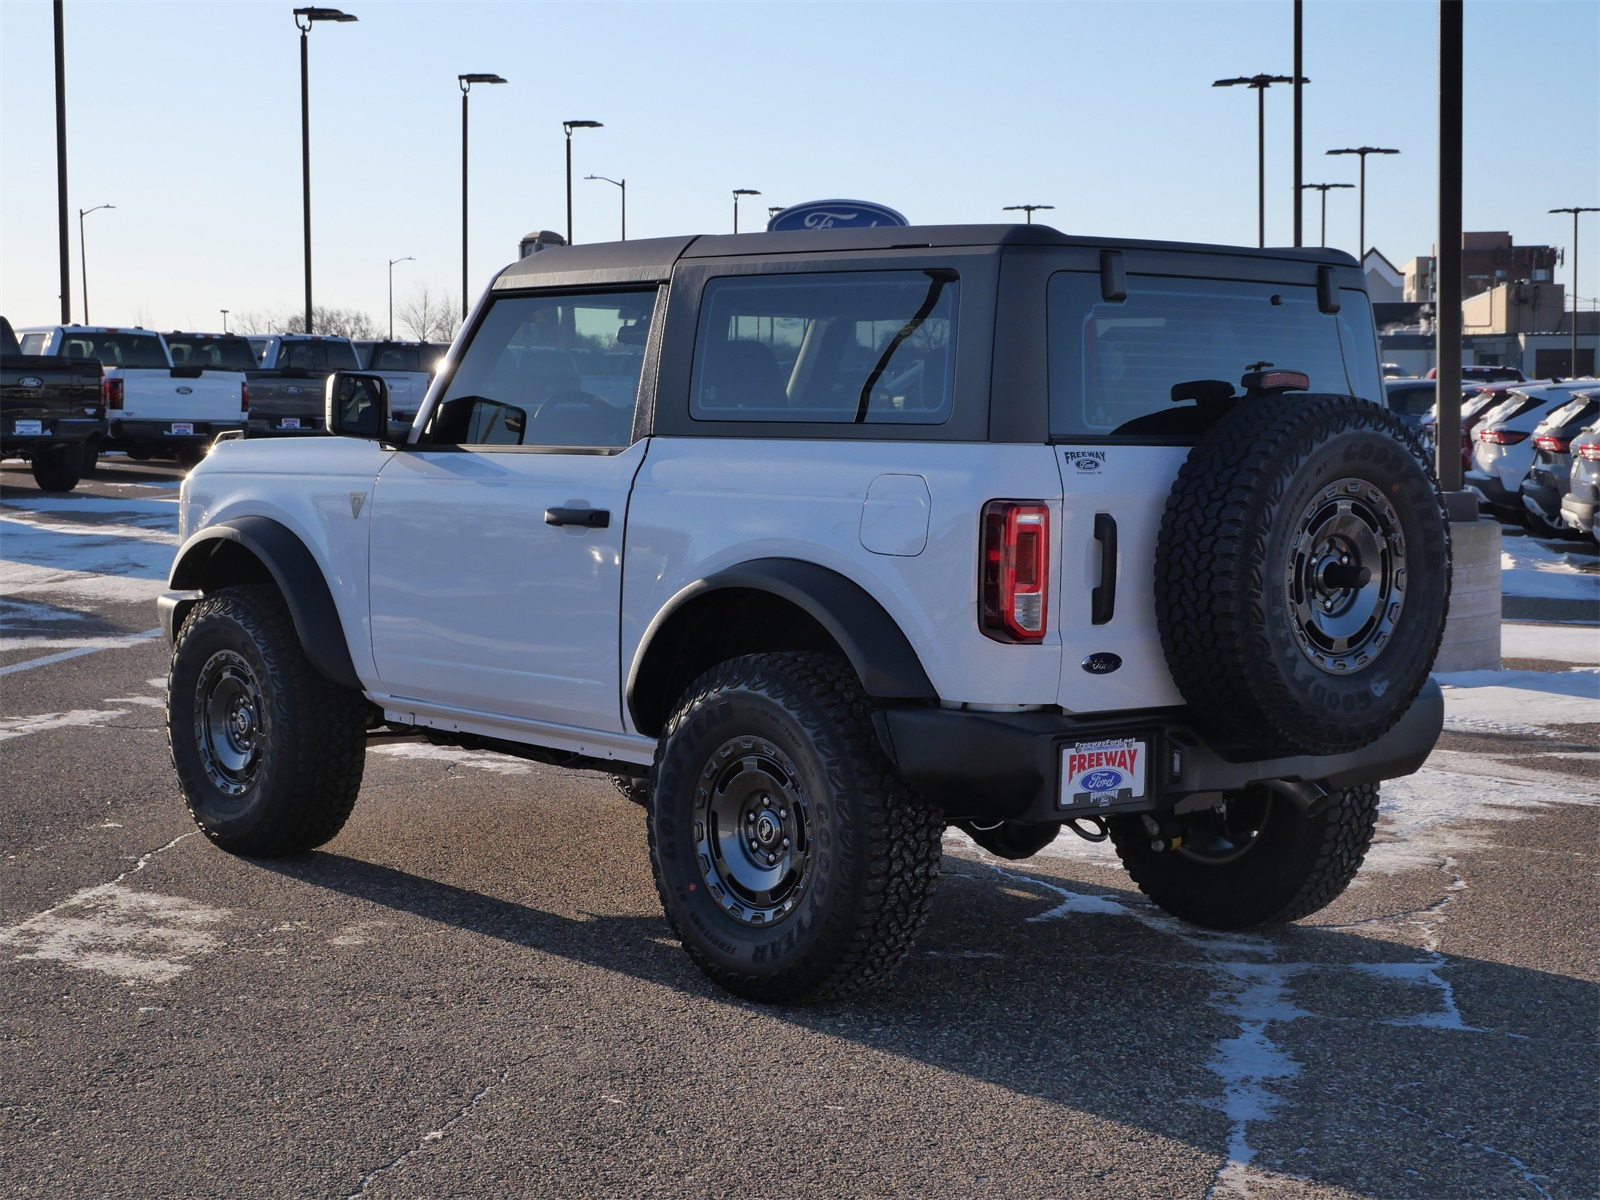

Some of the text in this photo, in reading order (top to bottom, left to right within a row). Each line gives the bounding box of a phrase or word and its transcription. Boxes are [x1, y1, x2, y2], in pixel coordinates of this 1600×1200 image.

[1064, 451, 1106, 465] FREEWAY
[1068, 749, 1138, 786] FREEWAY
[1088, 772, 1115, 788] Ford
[1090, 789, 1119, 803] FREEWAY
